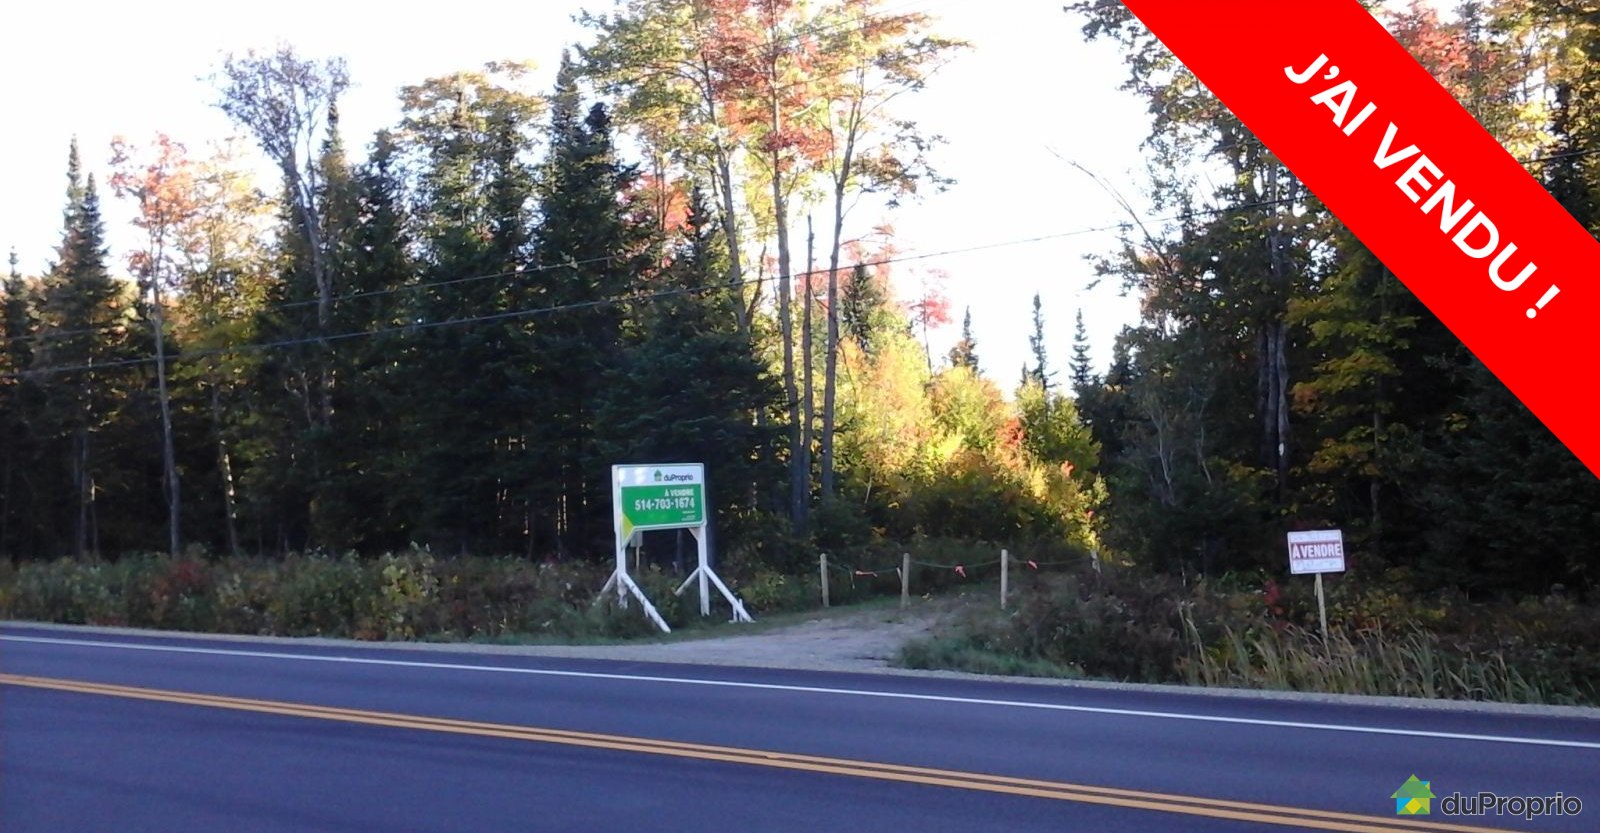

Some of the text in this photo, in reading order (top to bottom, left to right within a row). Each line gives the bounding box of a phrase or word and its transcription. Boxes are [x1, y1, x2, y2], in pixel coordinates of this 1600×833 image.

[663, 473, 694, 482] duProprio
[670, 488, 694, 497] VENDRE
[634, 497, 695, 511] 514-703-1674
[1300, 543, 1341, 558] VENDRE
